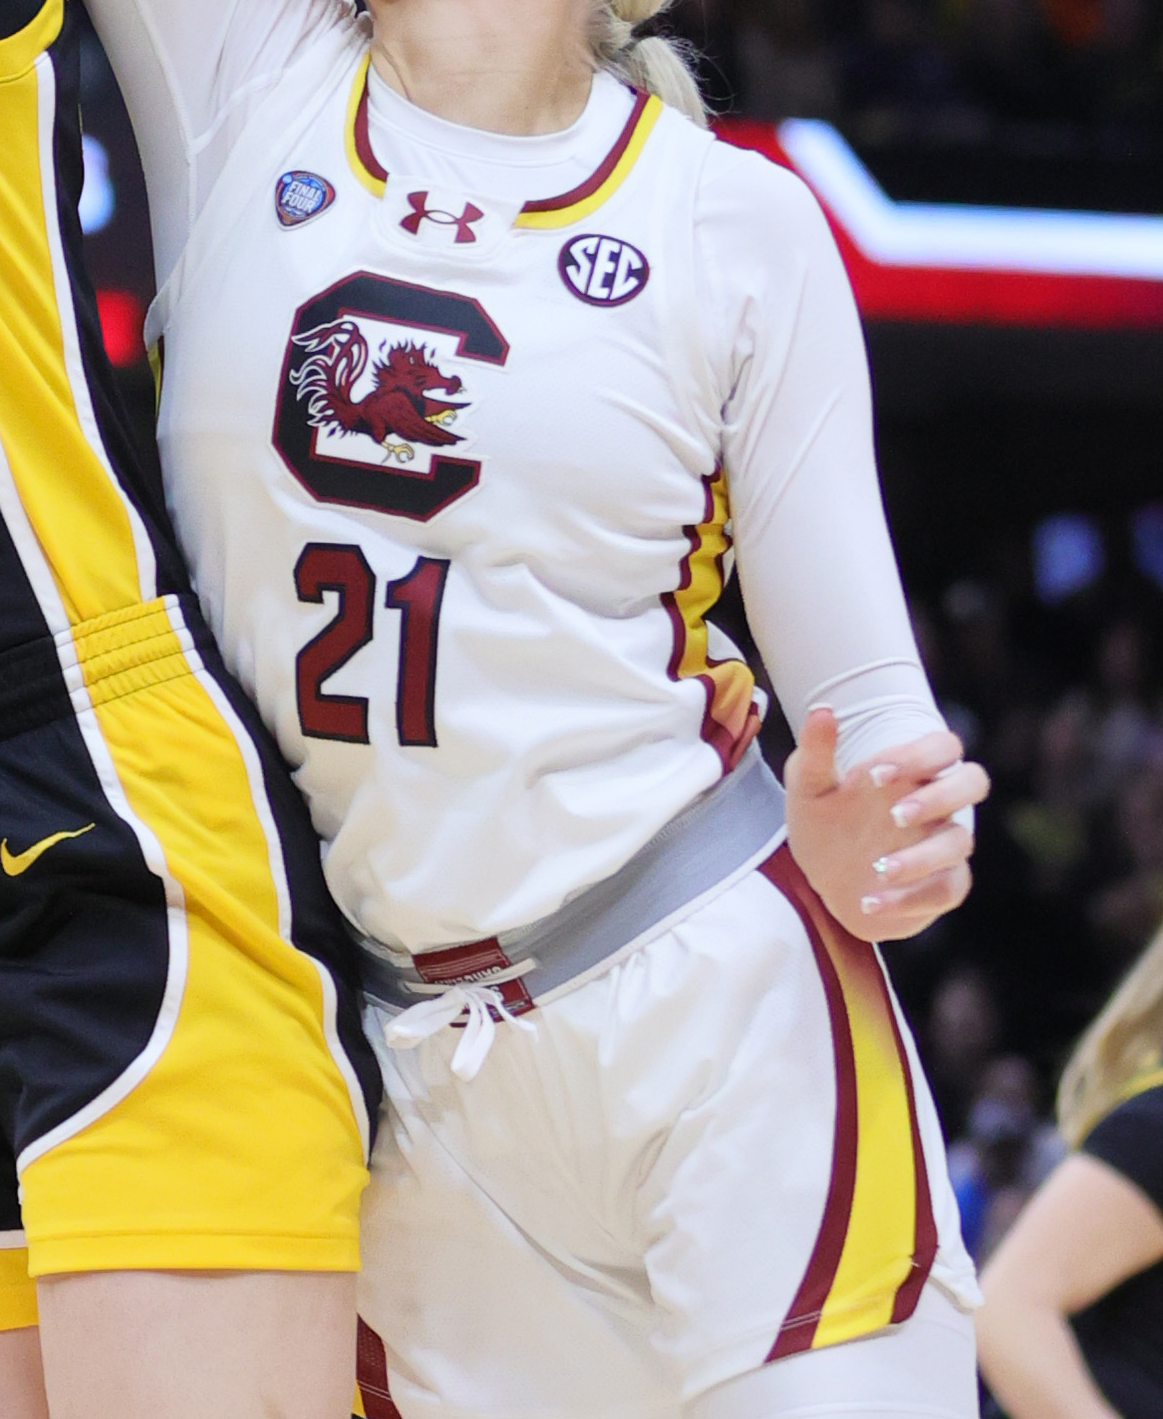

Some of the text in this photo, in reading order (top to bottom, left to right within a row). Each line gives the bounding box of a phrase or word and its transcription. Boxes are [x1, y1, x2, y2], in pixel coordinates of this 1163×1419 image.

[281, 191, 316, 214] FOUR
[288, 180, 322, 203] FINAL
[564, 236, 644, 301] SEC
[293, 541, 451, 748] 21
